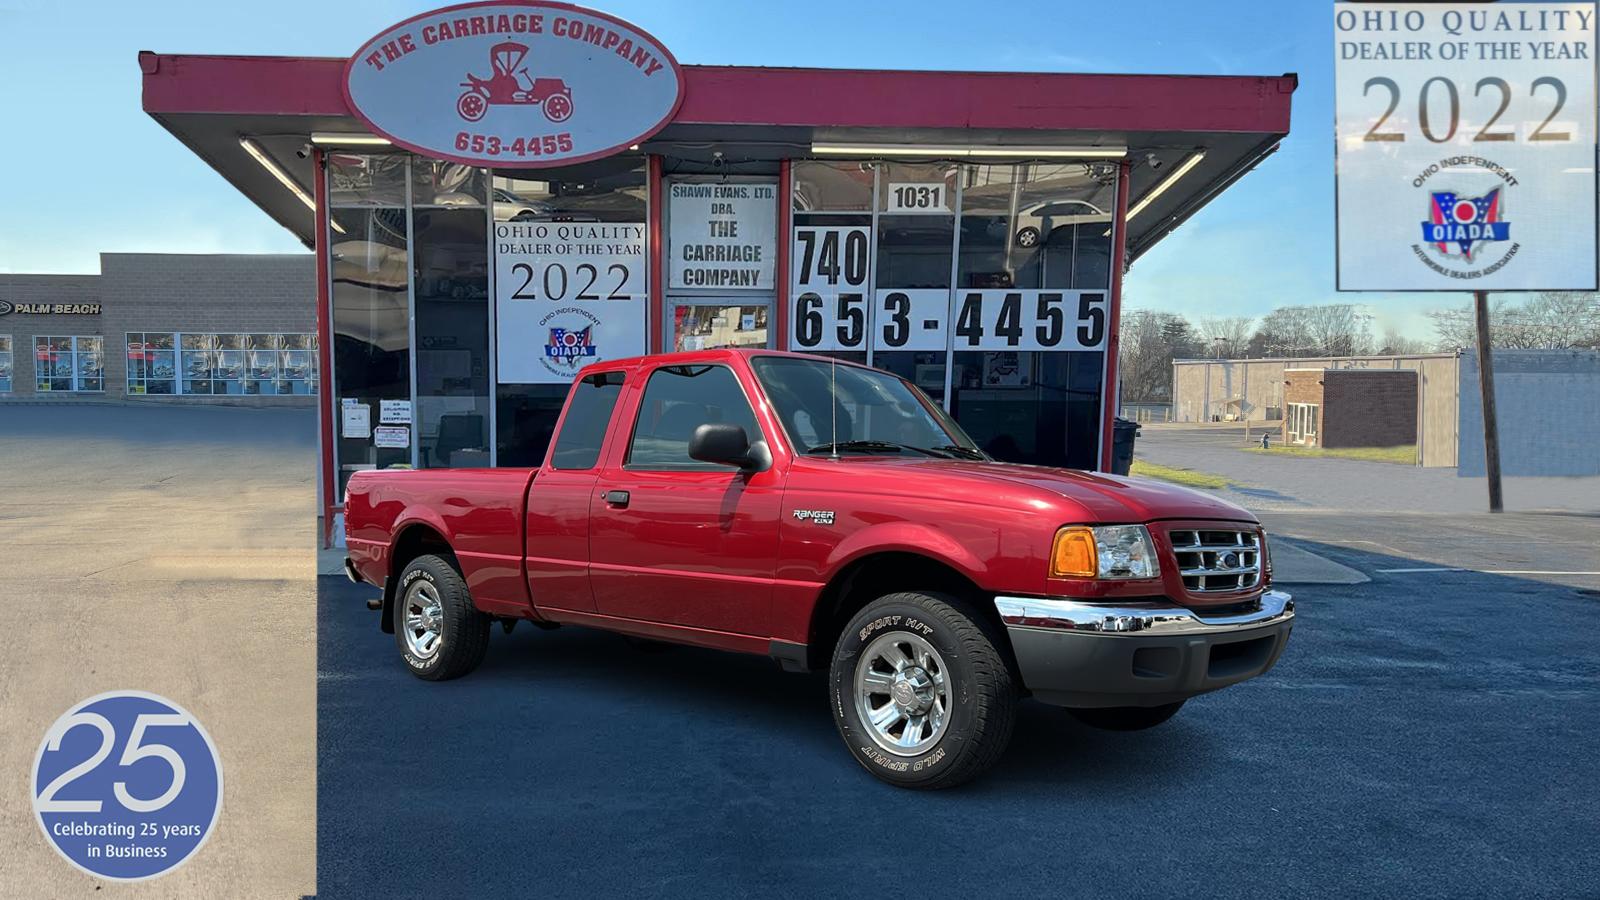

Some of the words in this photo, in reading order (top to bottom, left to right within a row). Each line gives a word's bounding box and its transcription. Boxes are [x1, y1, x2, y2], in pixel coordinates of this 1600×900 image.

[1336, 10, 1425, 31] OHIO
[1442, 10, 1593, 36] QUALITY
[366, 33, 416, 72] THE
[422, 14, 544, 46] CARRIAGE
[553, 17, 664, 77] COMPANY
[1340, 41, 1433, 60] DEALER
[1438, 41, 1469, 60] OF
[1475, 41, 1522, 60] THE
[1528, 41, 1589, 60] YEAR
[1362, 76, 1571, 143] 2022
[455, 132, 573, 157] 653-4455
[1412, 164, 1440, 188] OHIO
[1440, 156, 1519, 187] INDEPENDENT
[672, 185, 713, 199] SHAWN
[754, 186, 775, 199] LTD.
[894, 186, 940, 208] 1031
[711, 203, 736, 215] DBA.
[496, 225, 552, 239] OHIO
[557, 225, 645, 241] QUALITY
[708, 220, 738, 238] THE
[1432, 224, 1495, 240] OIADA
[499, 243, 552, 255] DEALER
[555, 243, 574, 255] OF
[576, 243, 604, 255] THE
[606, 243, 642, 255] YEAR
[683, 244, 762, 262] CARRIAGE
[796, 230, 868, 286] 740
[1411, 244, 1449, 277] AUTOMOBILE
[1450, 269, 1482, 280] DEALERS
[510, 262, 632, 301] 2022
[683, 268, 760, 287] COMPANY
[15, 303, 51, 314] PALM
[54, 303, 100, 314] BEACH
[551, 346, 588, 356] OIADA
[859, 615, 901, 642] SPORT
[861, 746, 909, 772] SPIRIT
[913, 747, 946, 772] WILD
